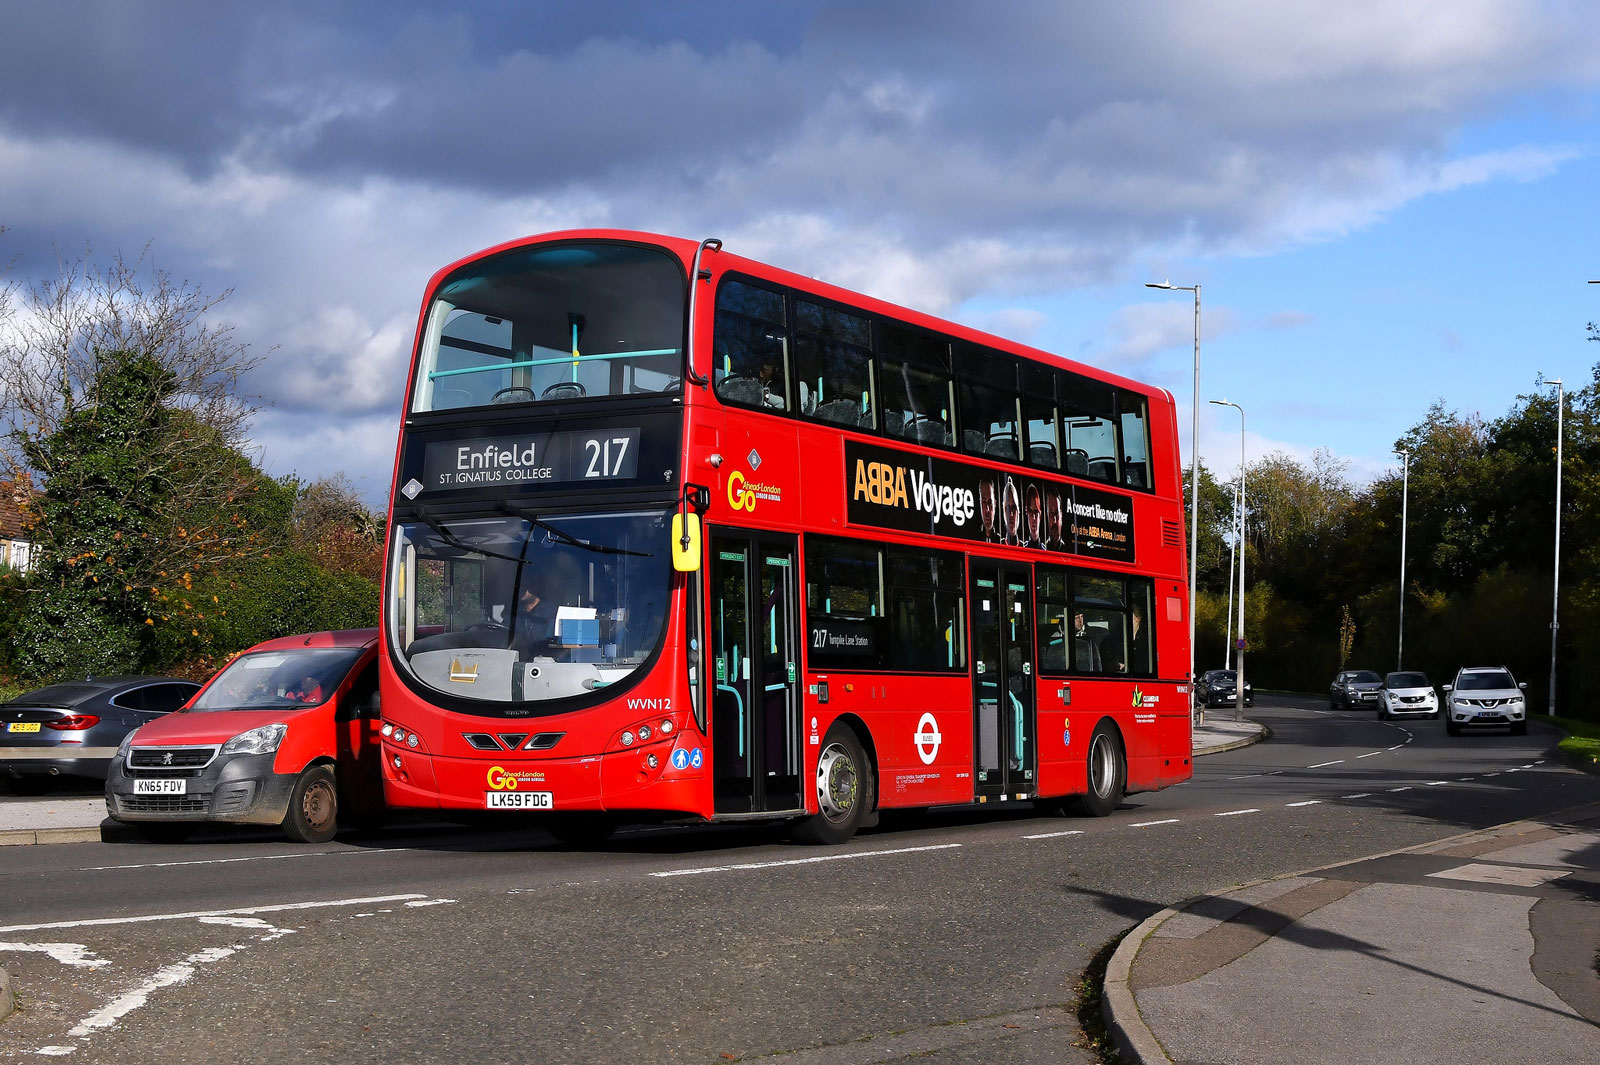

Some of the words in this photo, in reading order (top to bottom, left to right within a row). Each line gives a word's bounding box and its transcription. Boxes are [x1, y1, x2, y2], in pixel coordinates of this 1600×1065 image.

[456, 442, 536, 470] Enfield
[584, 437, 631, 478] 217
[439, 472, 453, 484] ST.
[455, 469, 502, 483] IGNATIUS
[505, 467, 552, 480] COLLEGE
[727, 470, 756, 512] Go
[853, 458, 909, 509] ABBA
[910, 468, 975, 526] Voyage
[1067, 498, 1072, 513] A
[1073, 503, 1095, 518] concert
[1095, 504, 1105, 519] like
[1106, 510, 1113, 521] no
[1114, 509, 1128, 524] other
[812, 628, 828, 648] 217
[627, 698, 672, 711] WVN12
[138, 780, 162, 792] KN65
[163, 780, 183, 792] FDV
[487, 765, 518, 790] Go
[491, 794, 522, 807] LK59
[524, 794, 548, 807] FDG
